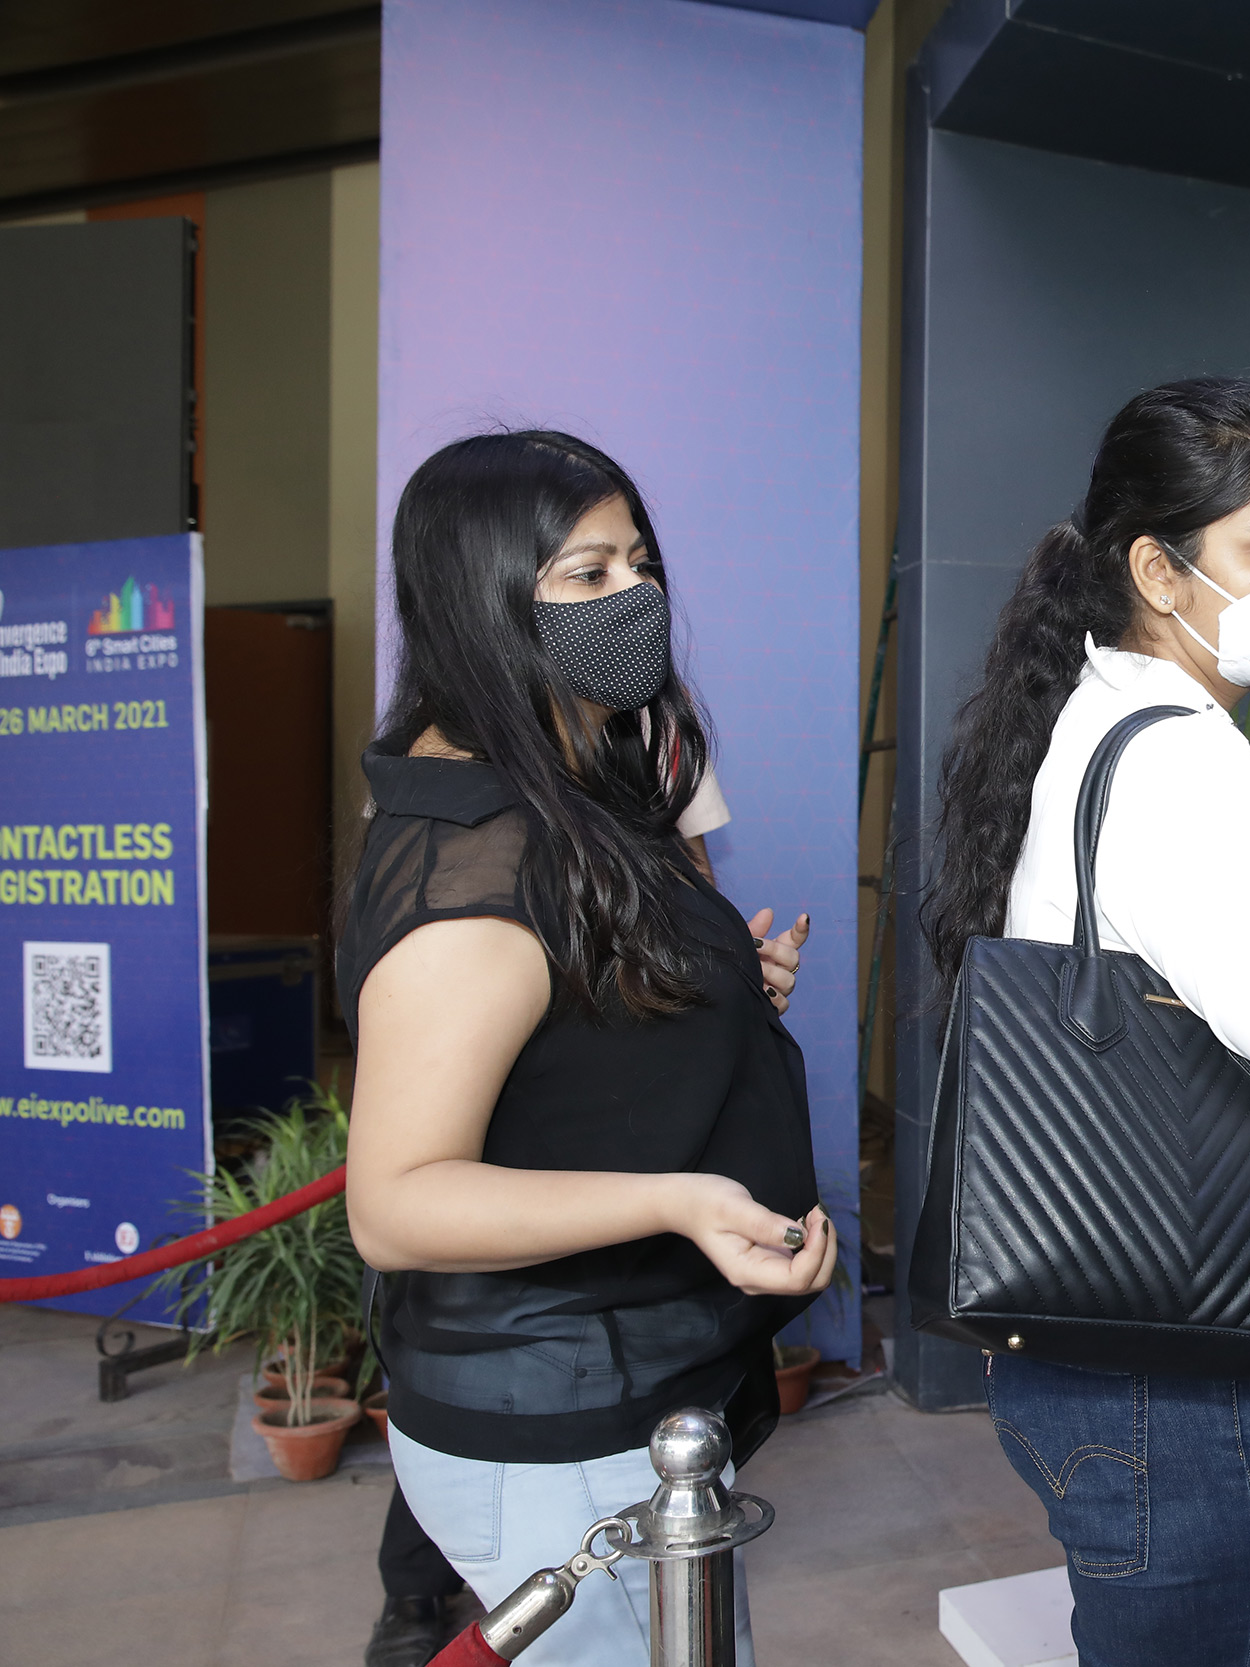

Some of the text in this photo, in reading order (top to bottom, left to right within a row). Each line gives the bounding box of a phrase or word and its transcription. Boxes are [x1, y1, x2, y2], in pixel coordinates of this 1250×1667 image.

[86, 652, 179, 673] INDIA EXPO
[102, 636, 139, 656] Smart
[140, 634, 178, 653] Cities
[33, 646, 68, 680] Expo
[0, 699, 169, 735] 26 MARCH 2021
[0, 822, 174, 860] NTACTLESS
[0, 868, 175, 906] GISTRATION
